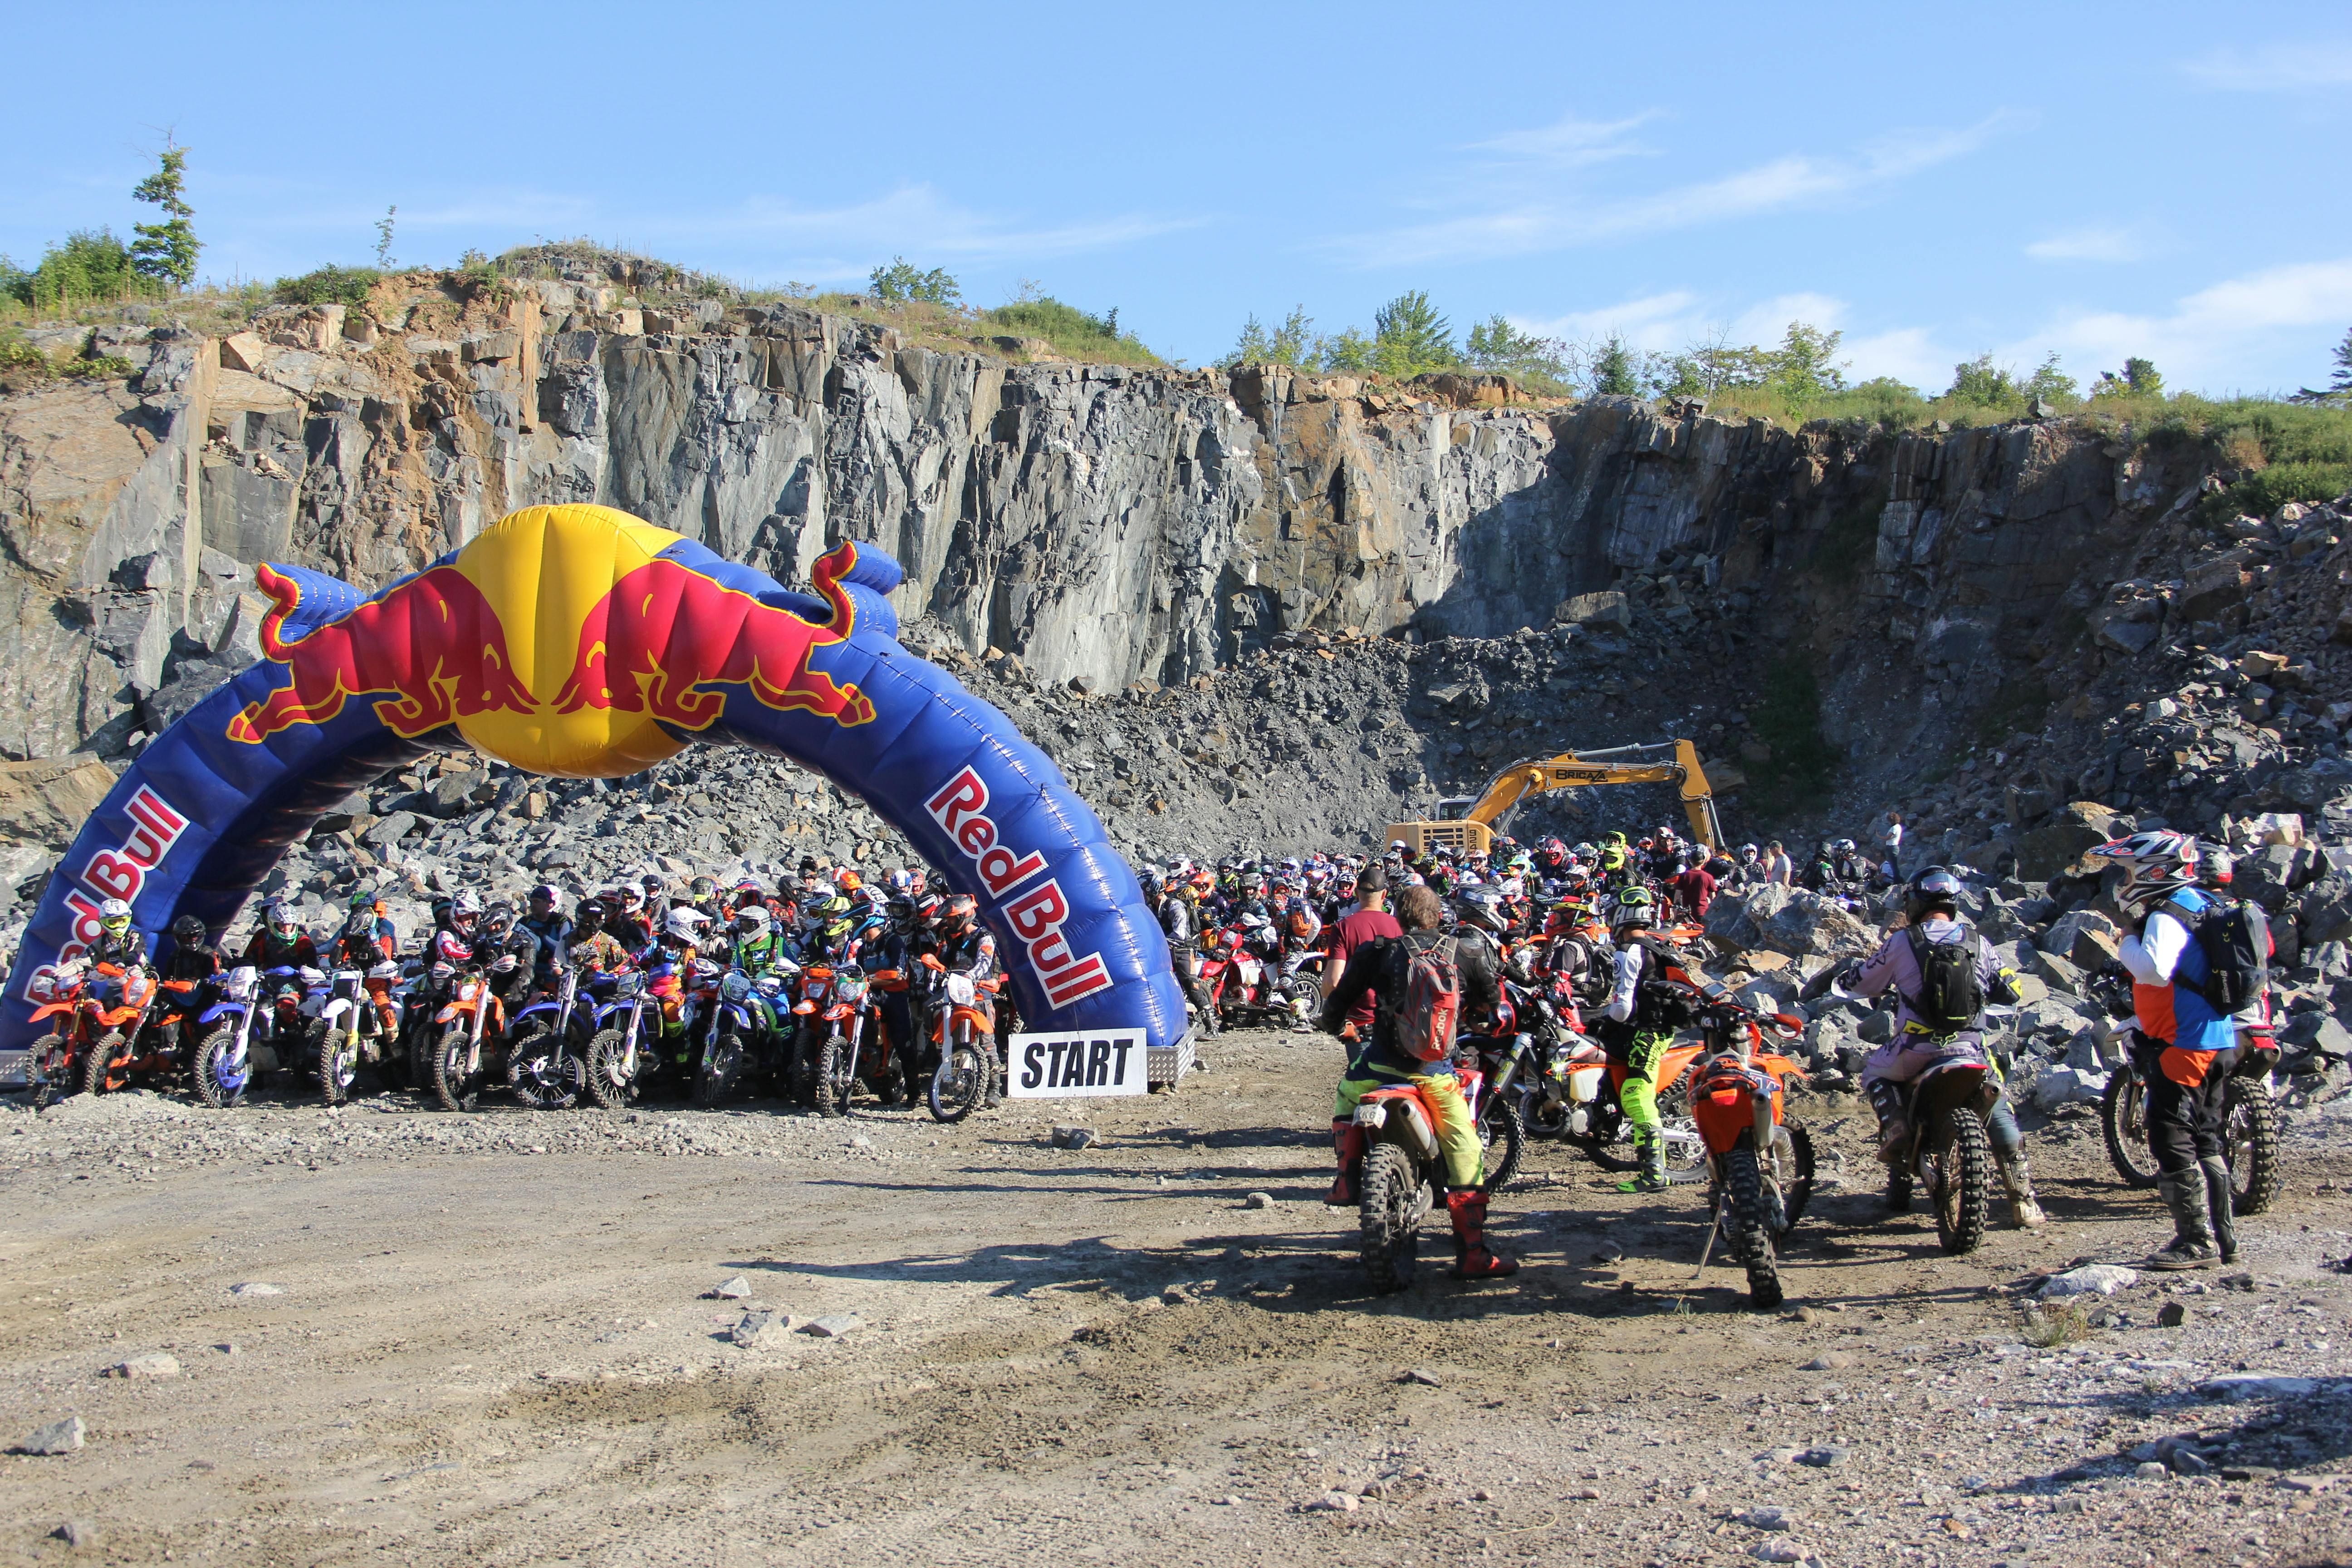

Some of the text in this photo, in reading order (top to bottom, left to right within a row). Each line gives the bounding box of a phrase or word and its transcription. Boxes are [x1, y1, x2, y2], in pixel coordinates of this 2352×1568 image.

[83, 786, 187, 903] Bull
[926, 767, 1111, 1007] Red Bull
[1021, 1039, 1133, 1088] START
[1431, 1008, 1449, 1050] Reebok
